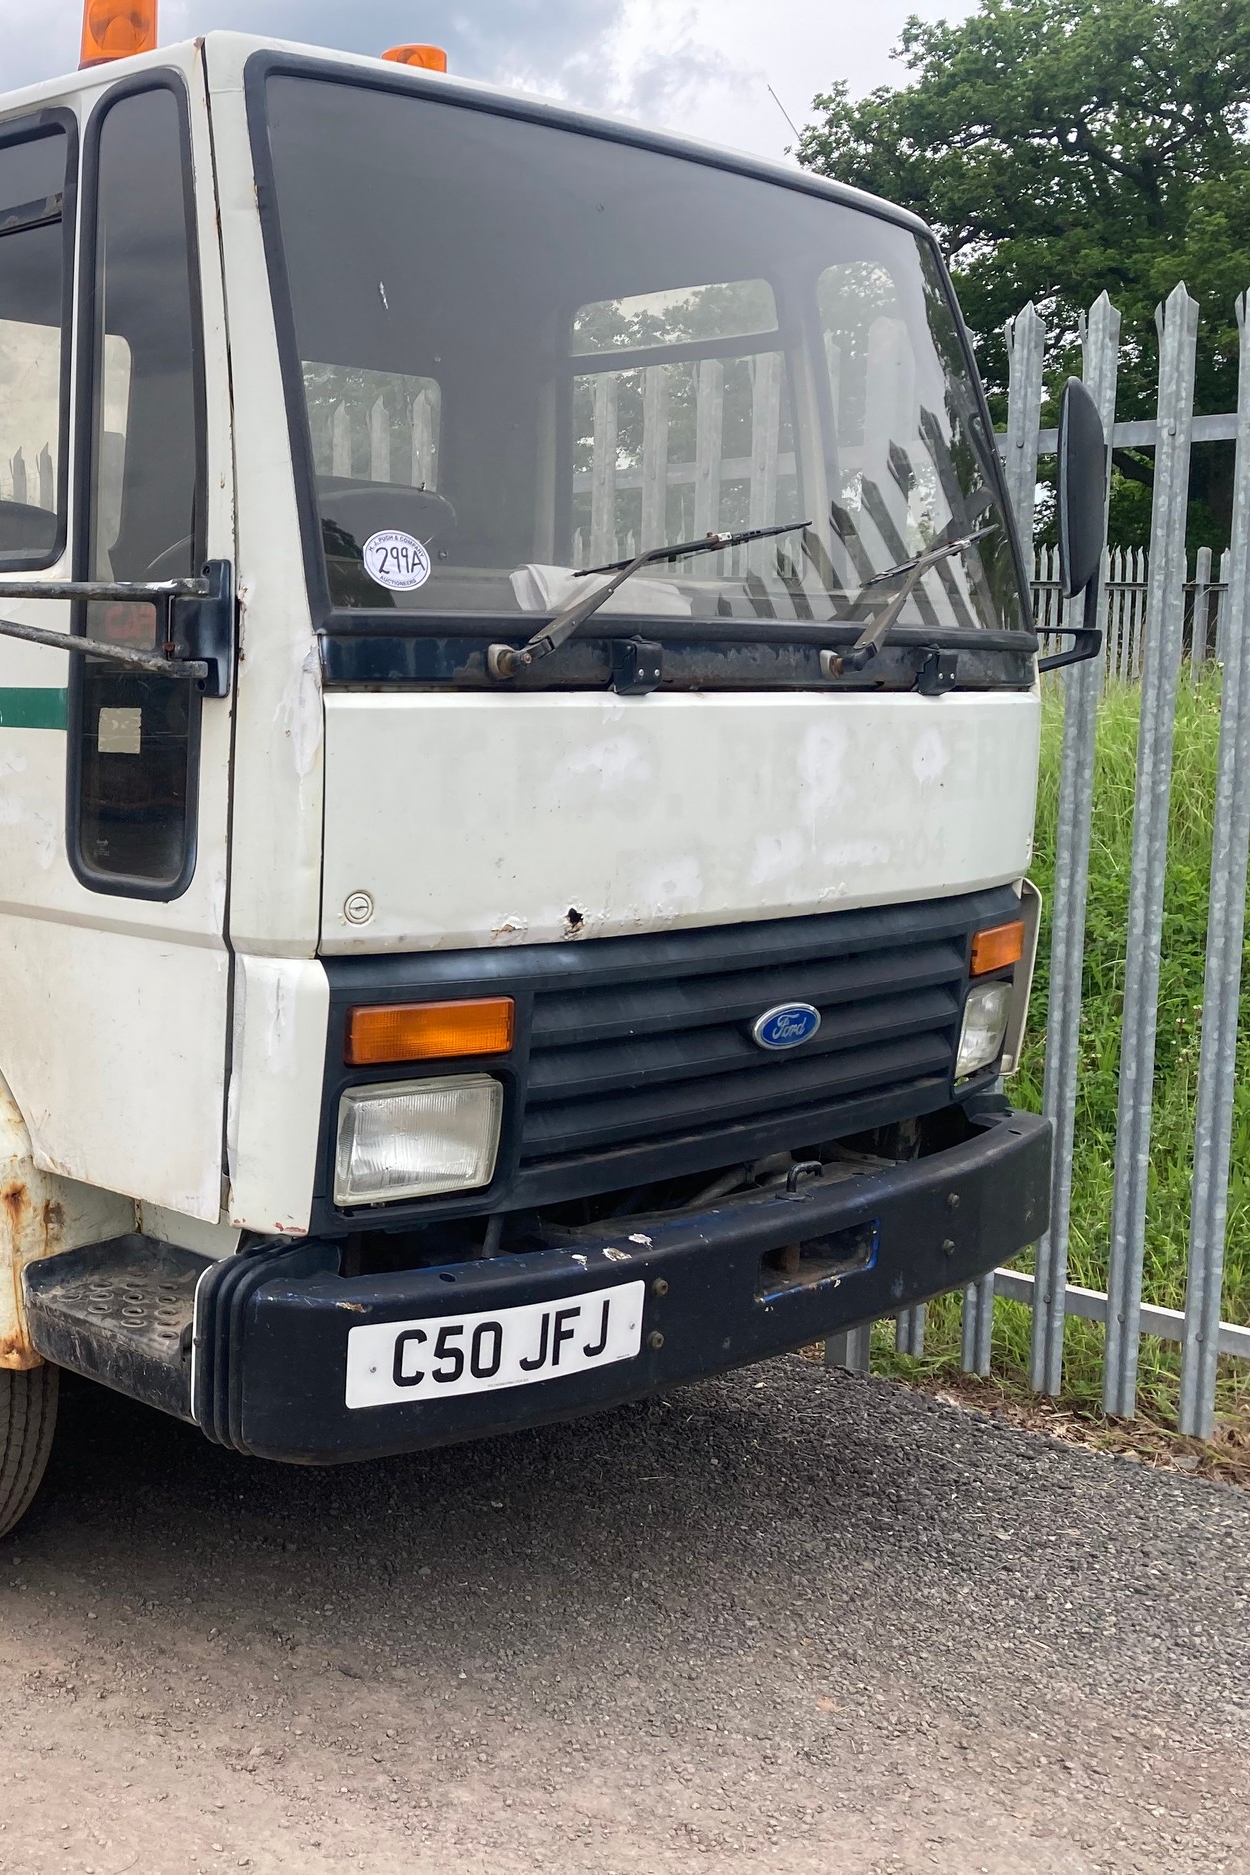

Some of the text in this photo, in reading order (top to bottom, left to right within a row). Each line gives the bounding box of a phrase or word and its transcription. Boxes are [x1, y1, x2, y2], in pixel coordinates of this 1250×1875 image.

[378, 535, 394, 543] PUGH
[399, 536, 425, 558] COMPANY
[375, 546, 426, 575] 299A
[379, 575, 417, 586] AUCTIONEERS
[772, 1013, 808, 1040] Ford
[392, 1299, 611, 1388] C50 JFJ
